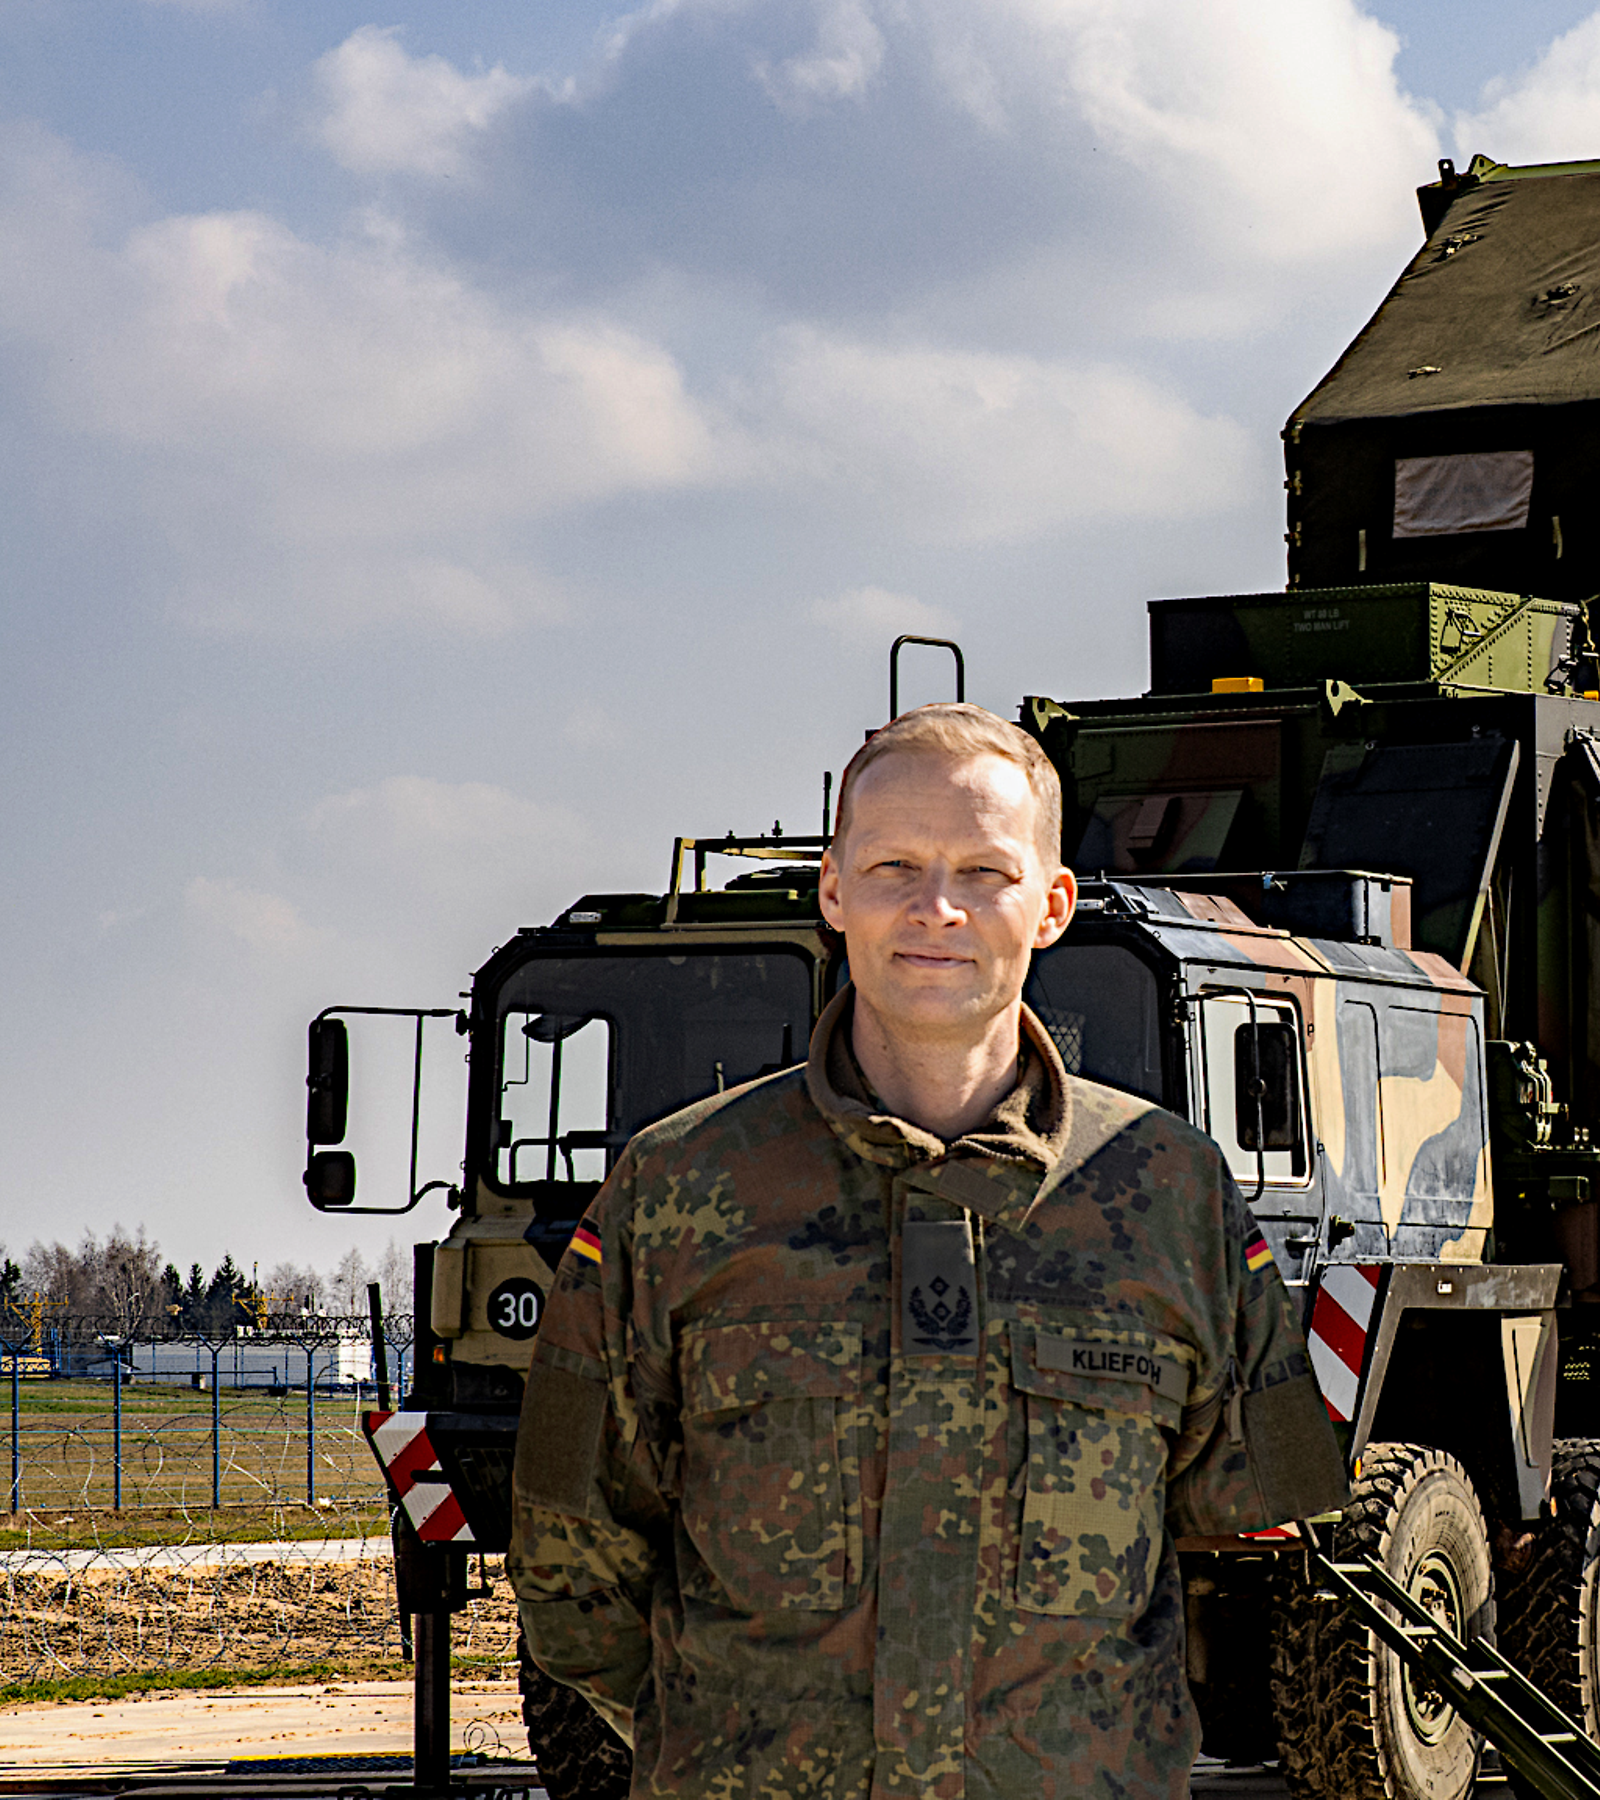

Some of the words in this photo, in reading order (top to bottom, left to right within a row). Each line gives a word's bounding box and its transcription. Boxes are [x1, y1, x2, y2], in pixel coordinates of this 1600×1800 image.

[1293, 622, 1312, 633] TWO
[1313, 621, 1331, 632] MAN
[1333, 620, 1350, 631] LIFT
[497, 1291, 538, 1328] 30
